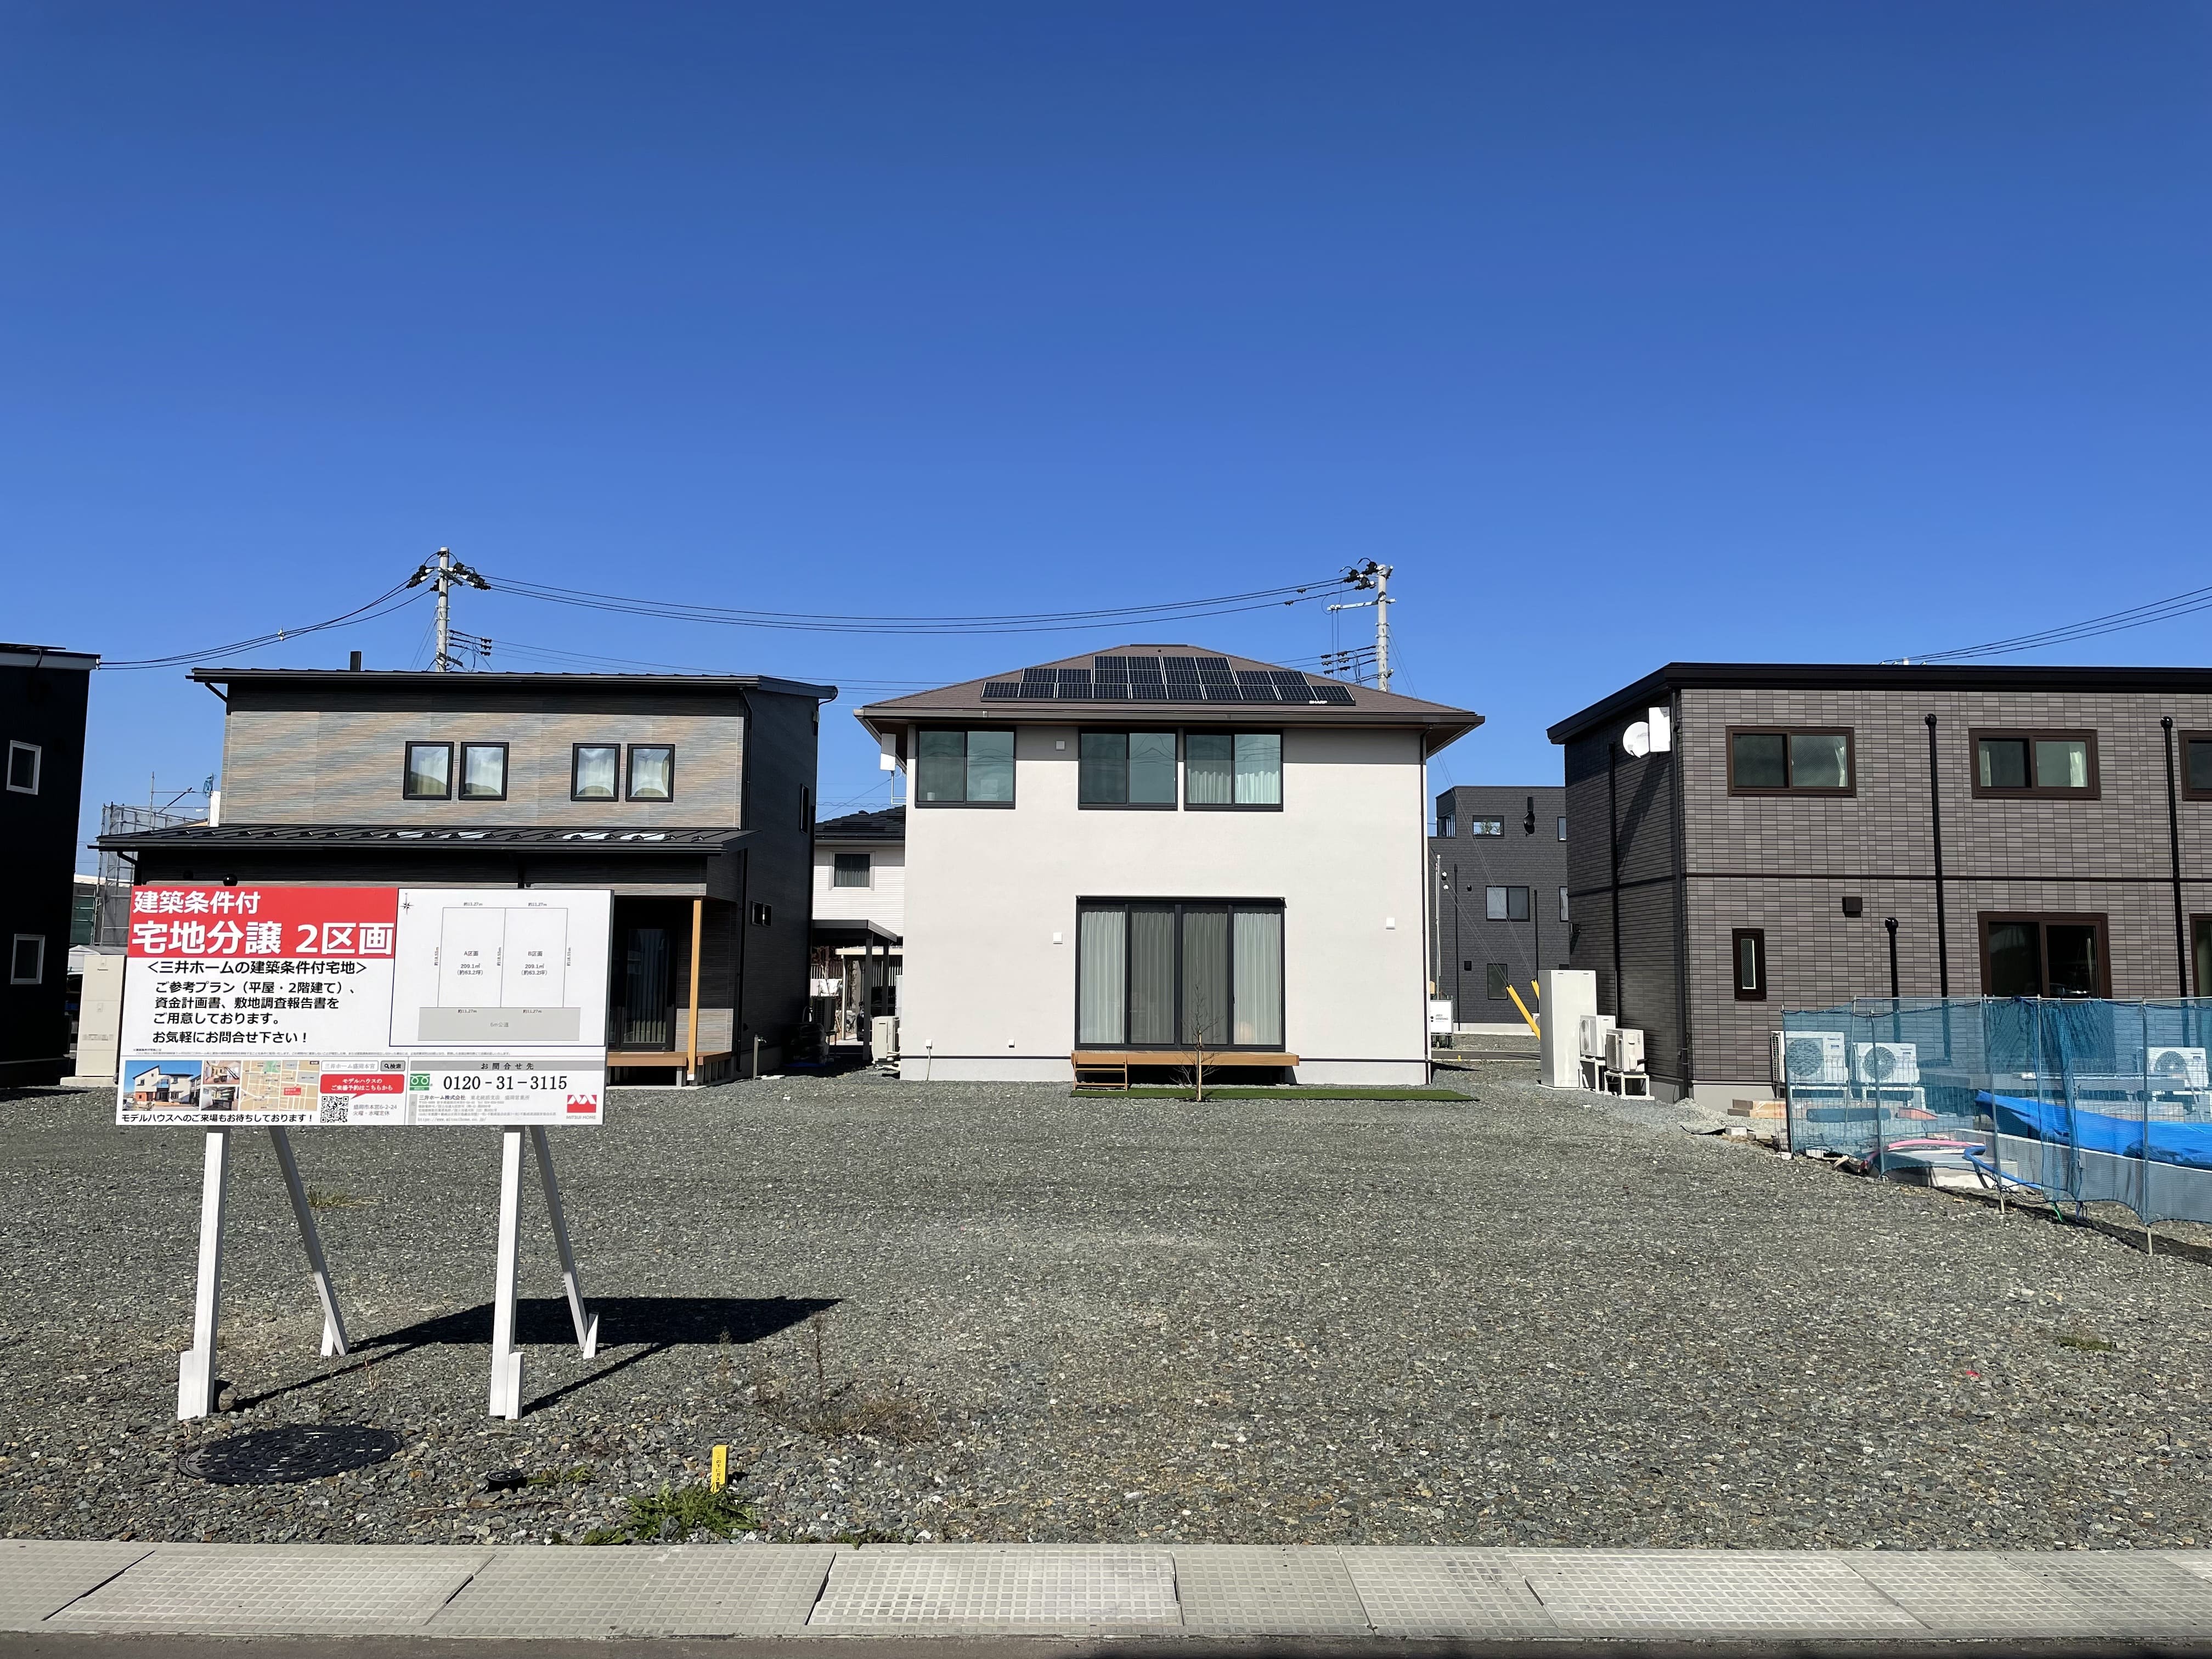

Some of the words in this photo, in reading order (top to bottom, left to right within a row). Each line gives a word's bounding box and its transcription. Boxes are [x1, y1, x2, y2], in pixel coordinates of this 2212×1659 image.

[133, 890, 261, 915] 建築条件付
[132, 920, 282, 954] 宅地分譲
[295, 922, 394, 955] 2区画
[147, 960, 367, 975] ＜三井ホームの建築条件付宅地＞
[156, 980, 354, 994] ご参考プラン（平屋・2階建て）、
[155, 996, 339, 1009] 資金計画書、敷地調査報告書を
[154, 1012, 278, 1025] ご用意しております。
[153, 1031, 306, 1043] お気軽にお問合せ下さい！
[481, 1062, 534, 1070] お問合せ先
[443, 1076, 567, 1090] 0120-31-3115
[121, 1114, 312, 1122] モデルハウスへのご来場もお待ちしております！
